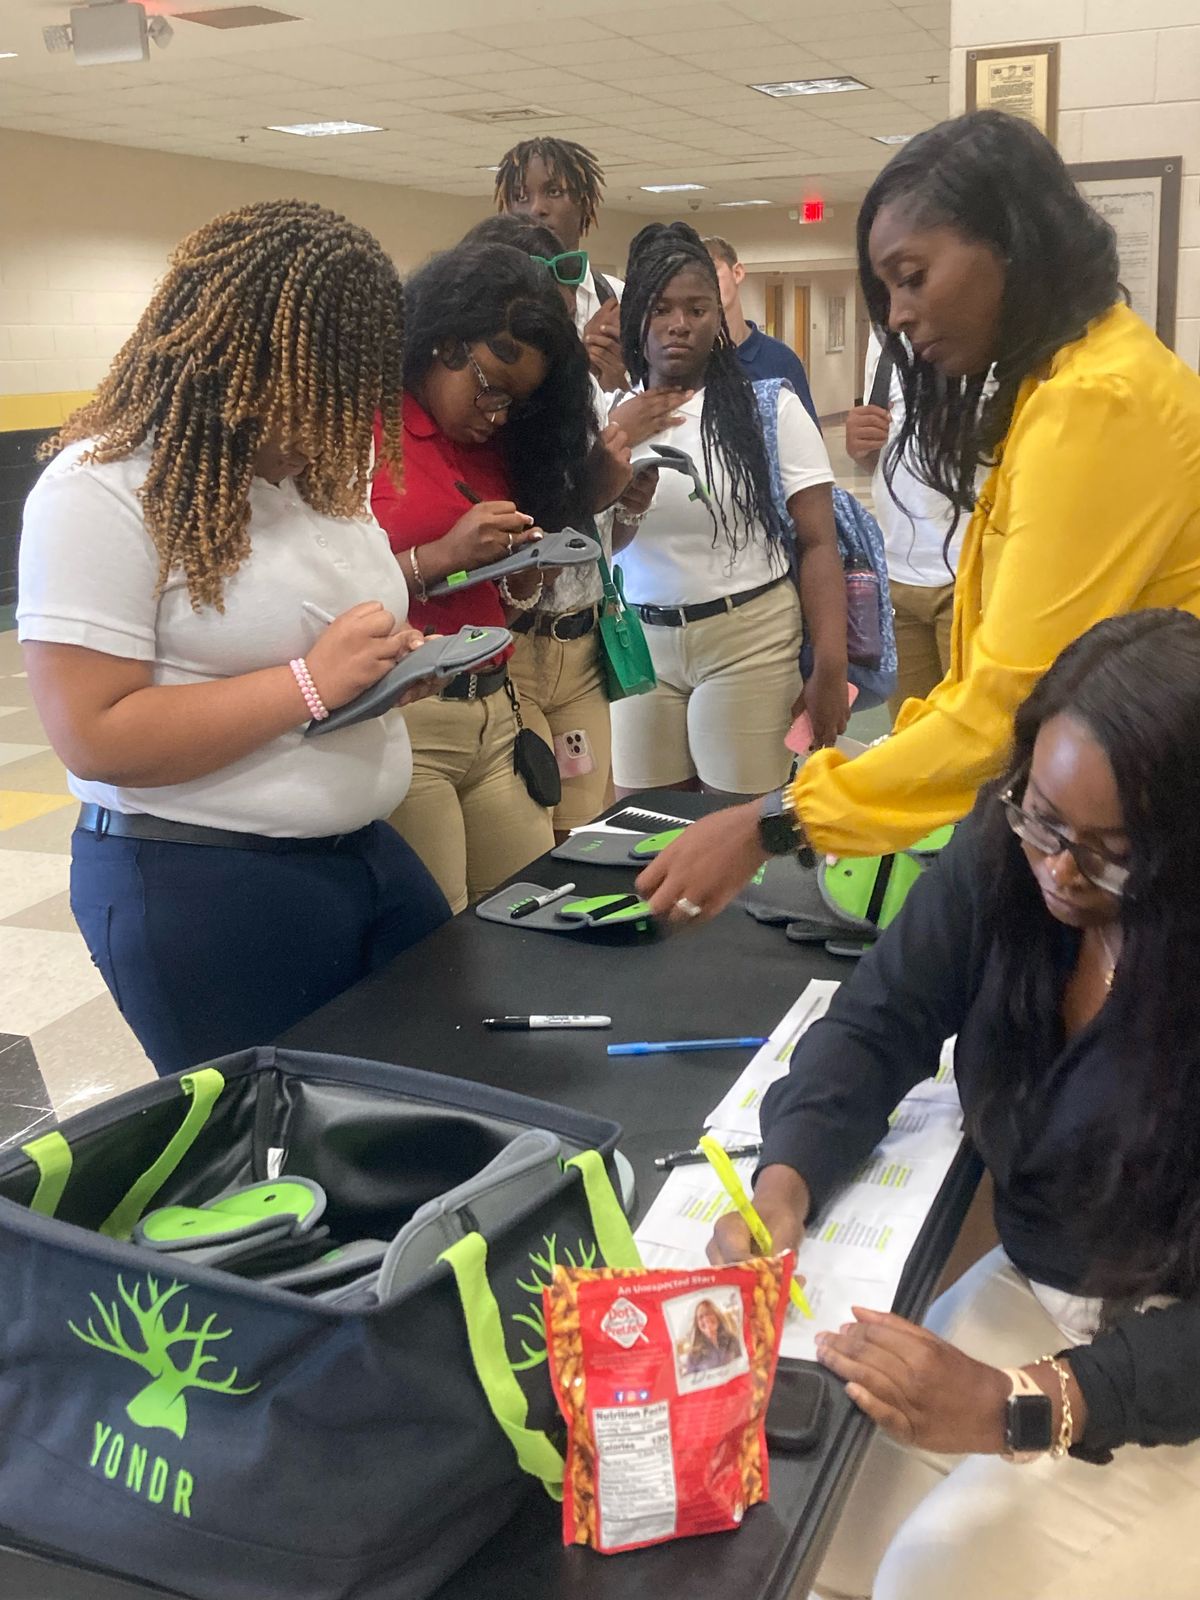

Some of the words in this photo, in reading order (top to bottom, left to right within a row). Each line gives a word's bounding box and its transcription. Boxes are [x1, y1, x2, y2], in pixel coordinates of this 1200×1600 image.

[617, 1286, 632, 1296] An
[633, 1277, 690, 1294] Unexpected
[691, 1275, 716, 1285] Start
[596, 1410, 640, 1421] Nutrition
[643, 1405, 667, 1418] Facts
[90, 1421, 193, 1518] YONDR
